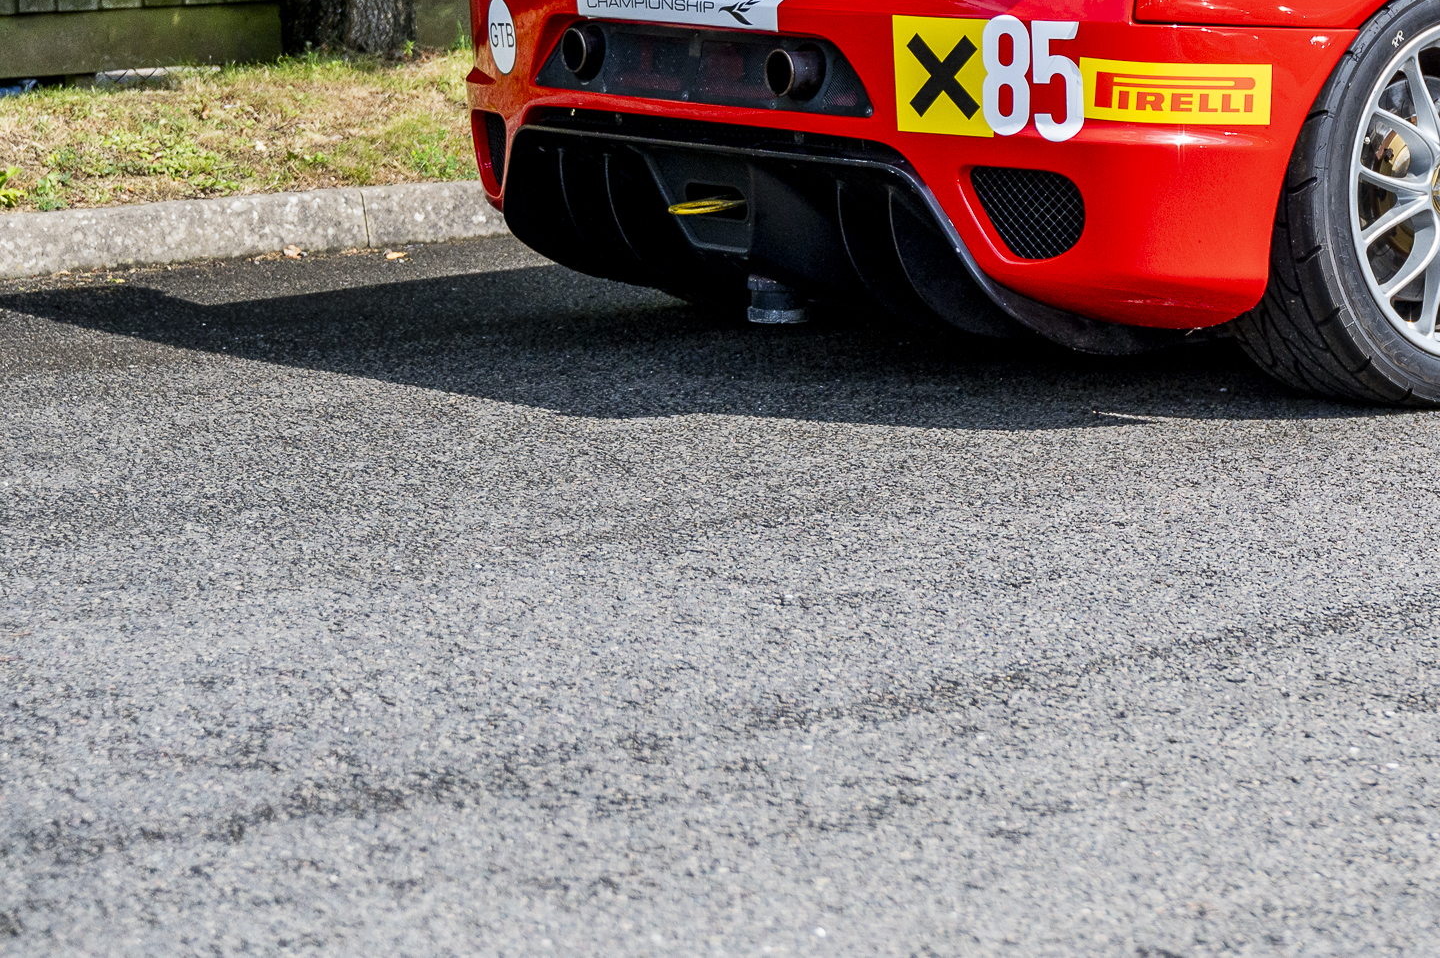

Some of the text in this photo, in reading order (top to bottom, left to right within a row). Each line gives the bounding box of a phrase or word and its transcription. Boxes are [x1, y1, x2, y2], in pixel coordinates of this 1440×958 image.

[490, 22, 515, 48] GTB
[982, 14, 1085, 142] 85
[1094, 71, 1256, 114] PIRELLI
